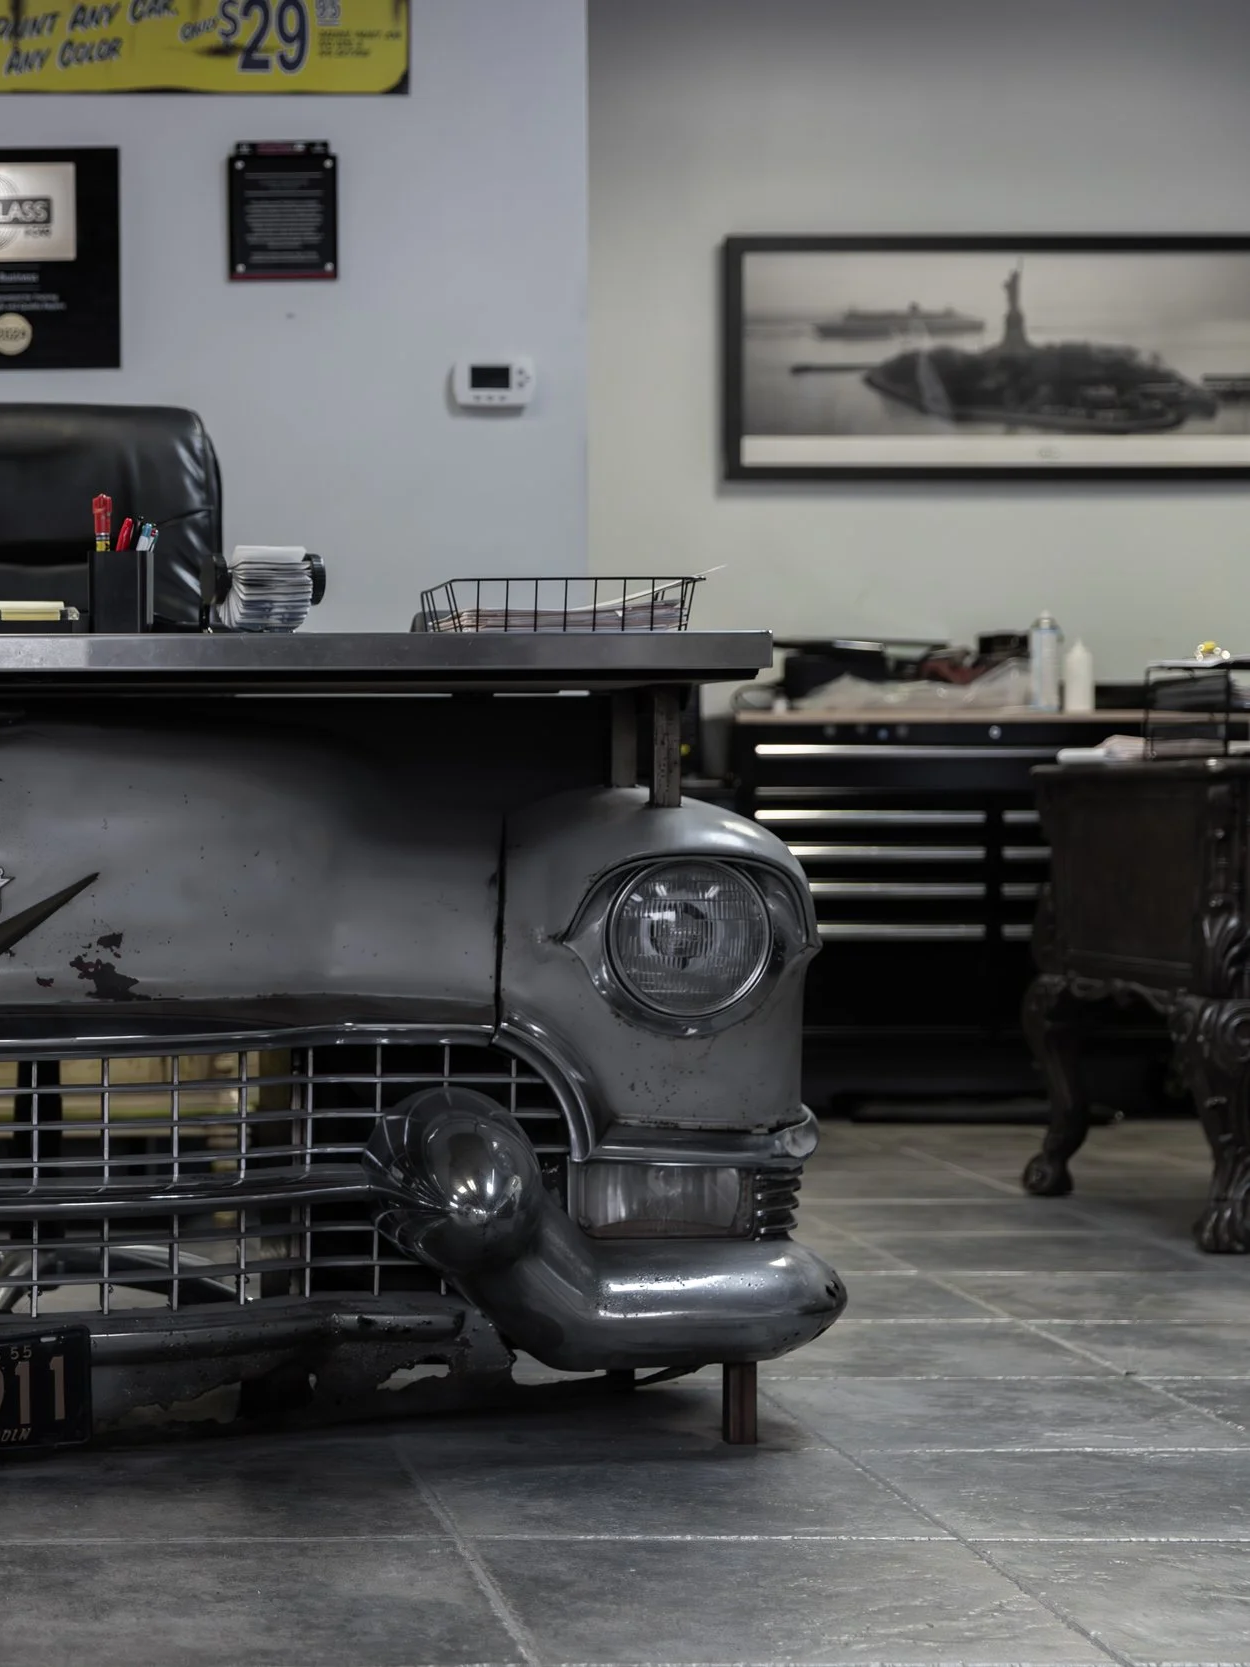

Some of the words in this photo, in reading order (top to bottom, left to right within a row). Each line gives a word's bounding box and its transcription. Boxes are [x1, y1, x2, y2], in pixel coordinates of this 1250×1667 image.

[67, 2, 121, 33] ANY
[3, 47, 50, 77] ANY
[56, 37, 123, 71] COLOR
[10, 1346, 32, 1360] 55
